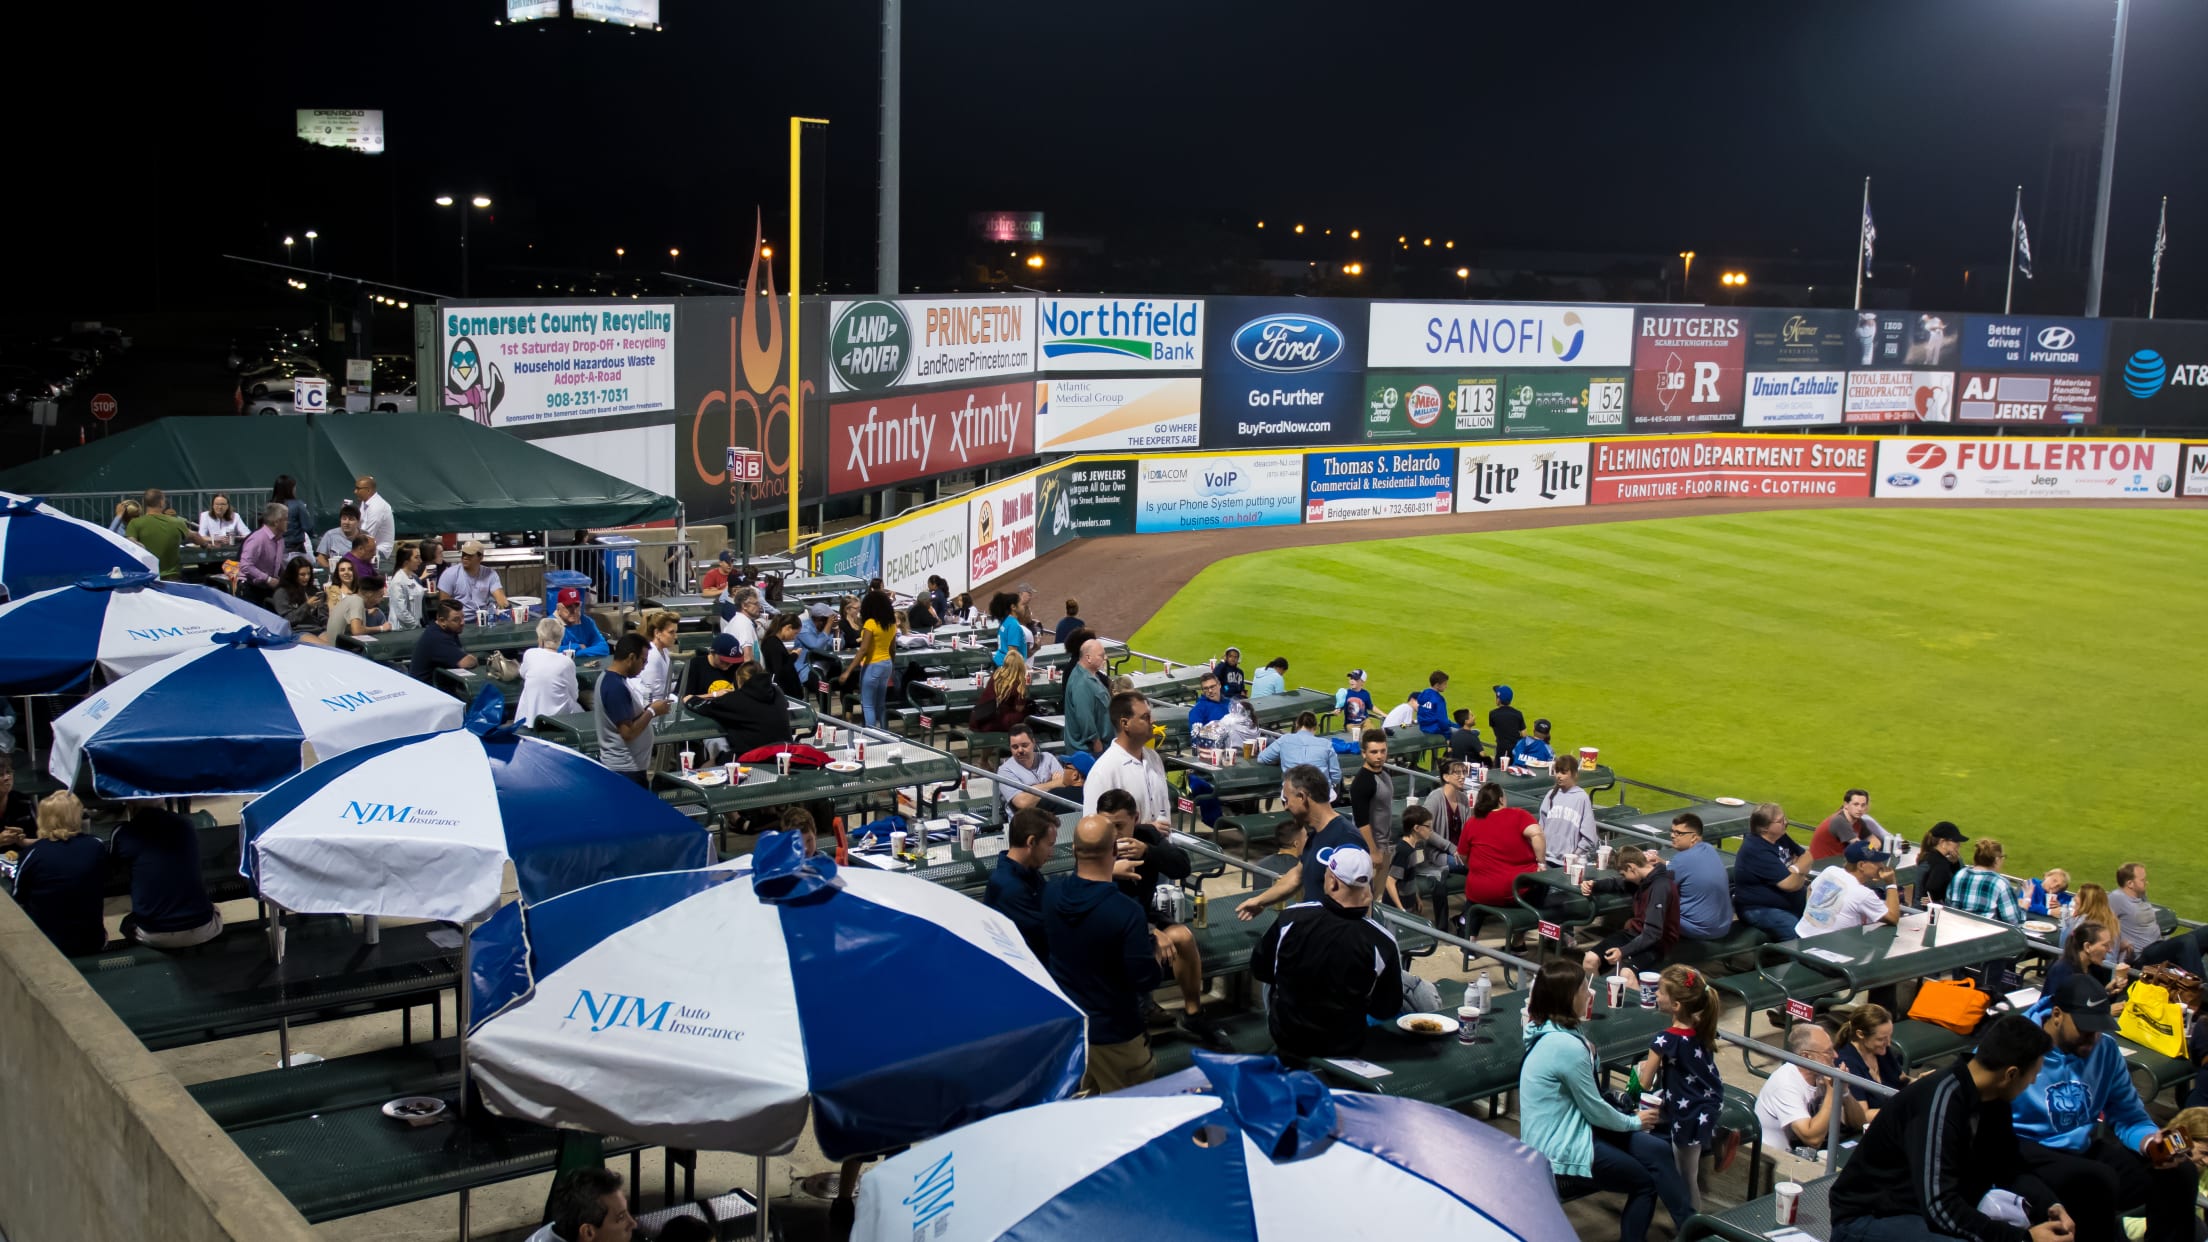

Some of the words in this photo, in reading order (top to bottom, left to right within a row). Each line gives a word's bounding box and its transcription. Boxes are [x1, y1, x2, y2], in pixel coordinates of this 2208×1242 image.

[448, 312, 536, 336] Somerset
[541, 311, 598, 334] County
[602, 310, 671, 332] Recycling
[926, 306, 1021, 347] PRINCETON
[1042, 301, 1197, 337] Northfield
[1642, 317, 1739, 338] RUTGERS
[1884, 322, 1903, 330] IZOD
[847, 315, 889, 344] LAND
[1426, 317, 1543, 354] SANOFI
[1988, 324, 2021, 336] Better
[500, 342, 518, 355] 1st
[522, 341, 570, 356] Saturday
[572, 338, 615, 353] Drop-Off
[623, 337, 666, 350] Recycling
[1154, 341, 1194, 360] Bank
[1254, 323, 1323, 361] Ford
[1987, 337, 2020, 348] drives
[514, 358, 571, 374] Household
[574, 356, 625, 370] Hazardous
[628, 354, 656, 367] Waste
[850, 345, 900, 374] ROVER
[918, 350, 1028, 376] LandRoverPrinceton.com
[2006, 352, 2019, 361] us
[2030, 352, 2079, 363] HYUNDAI
[554, 370, 622, 386] Adopt-A-Road
[1691, 362, 1720, 403] R
[1752, 376, 1789, 397] Union
[1790, 376, 1839, 396] Catholic
[1851, 374, 1878, 385] TOTAL
[1880, 373, 1913, 385] HEALTH
[2054, 379, 2092, 387] Materials
[1056, 382, 1091, 392] Atlantic
[1849, 386, 1913, 398] CHIROPRACTIC
[1962, 377, 1998, 400] AJ
[2052, 387, 2090, 396] Handling
[308, 390, 322, 406] C
[546, 388, 629, 408] 908-231-7031
[1056, 393, 1092, 403] Medical
[1094, 392, 1124, 404] Group
[1248, 390, 1270, 407] Go
[1272, 389, 1324, 406] Further
[1448, 390, 1457, 411] $
[1460, 387, 1494, 413] 113
[1580, 389, 1589, 408] $
[1602, 386, 1623, 410] 52
[2052, 394, 2096, 403] Equipment
[93, 402, 115, 412] STOP
[536, 413, 543, 421] by
[543, 411, 553, 419] the
[554, 409, 578, 418] Somerset
[579, 408, 597, 417] County
[1995, 403, 2047, 420] JERSEY
[1370, 415, 1391, 423] Lottery
[1456, 417, 1493, 428] MILLION
[1589, 414, 1621, 424] MILLION
[847, 403, 937, 482] xfinity
[950, 392, 1022, 462] xfinity
[1154, 424, 1167, 433] GO
[1169, 424, 1197, 433] WHERE
[1238, 420, 1331, 437] BuyFordNow.com
[1128, 437, 1144, 446] THE
[1146, 436, 1180, 445] EXPERTS
[1181, 435, 1197, 444] ARE
[728, 455, 734, 468] A
[1323, 456, 1373, 476] Thomas
[1377, 456, 1390, 474] S.
[1393, 452, 1440, 473] Belardo
[1599, 445, 1691, 472] FLEMINGTON
[1694, 443, 1804, 467] DEPARTMENT
[1810, 444, 1867, 468] STORE
[1957, 443, 2155, 471] FULLERTON
[735, 461, 742, 476] B
[748, 462, 759, 477] B
[1089, 470, 1126, 481] JEWELERS
[1090, 482, 1099, 492] All
[1100, 482, 1111, 492] Our
[1113, 482, 1126, 492] Own
[1204, 472, 1238, 487] VoIP
[1311, 478, 1361, 493] Commercial
[1363, 478, 1370, 490] &
[1373, 475, 1417, 490] Residential
[1420, 474, 1450, 490] Roofing
[1473, 462, 1519, 504] Lite
[1539, 459, 1583, 500] Lite
[1617, 482, 1678, 498] FURNITURE
[1685, 479, 1749, 495] FLOORING
[1761, 478, 1836, 494] CLOTHING
[2031, 474, 2058, 487] Jeep
[1984, 487, 2028, 497] Recognized
[1002, 497, 1019, 527] BRING
[1020, 491, 1034, 520] HOME
[1146, 501, 1154, 512] Is
[1157, 501, 1177, 513] your
[1180, 499, 1208, 510] Phone
[1211, 497, 1243, 510] System
[1246, 496, 1275, 510] putting
[1277, 495, 1296, 507] your
[1309, 504, 1324, 516] GAF
[1327, 505, 1370, 519] Bridgewater
[1372, 504, 1382, 516] NJ
[1389, 502, 1433, 515] 732-560-8311
[1436, 498, 1450, 511] GAF
[1180, 515, 1220, 526] business
[1222, 513, 1234, 523] on
[1237, 511, 1263, 522] hold?
[1001, 535, 1010, 563] THE
[1011, 525, 1034, 558] SAVINGS!
[816, 556, 822, 572] 3
[886, 550, 920, 586] PEARLE
[934, 533, 963, 565] VISION
[973, 543, 998, 581] ShopRite
[128, 626, 185, 642] NJM
[1227, 672, 1243, 684] GAP
[320, 690, 377, 713] NJM
[339, 800, 415, 825] NJM
[415, 807, 438, 816] Auto
[408, 815, 460, 827] Insurance
[563, 989, 677, 1032] NJM
[675, 1005, 711, 1021] Auto
[1790, 1007, 1804, 1016] TABLE
[1792, 1002, 1803, 1010] LEVEL
[668, 1019, 745, 1042] Insurance
[902, 1151, 954, 1232] NJM
